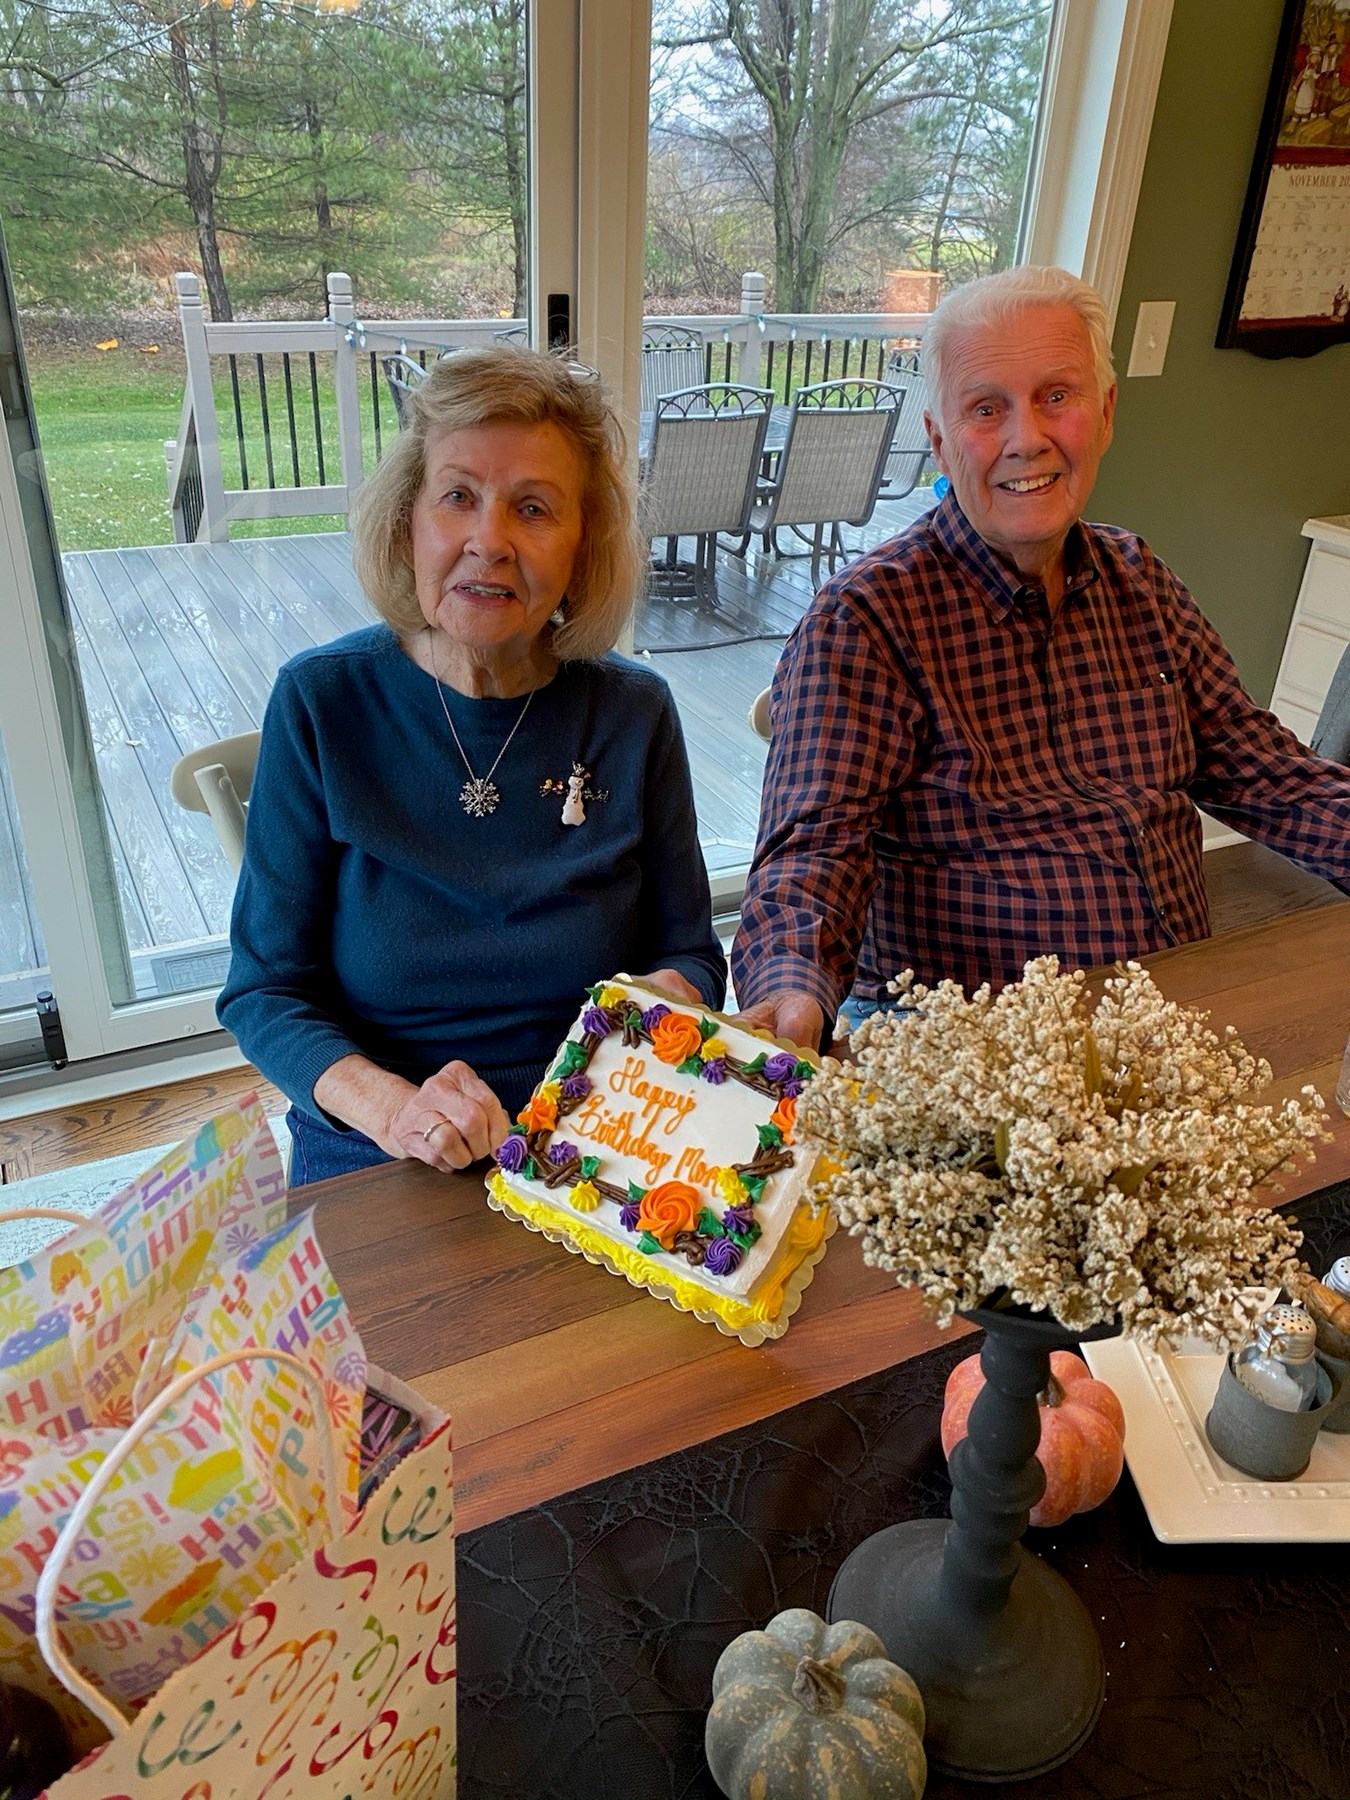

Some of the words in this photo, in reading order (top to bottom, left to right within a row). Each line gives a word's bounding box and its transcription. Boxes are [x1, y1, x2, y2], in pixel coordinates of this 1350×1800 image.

[1290, 174, 1337, 187] NOVEMBER
[608, 1056, 696, 1135] Happy
[568, 1094, 672, 1185] Birthday
